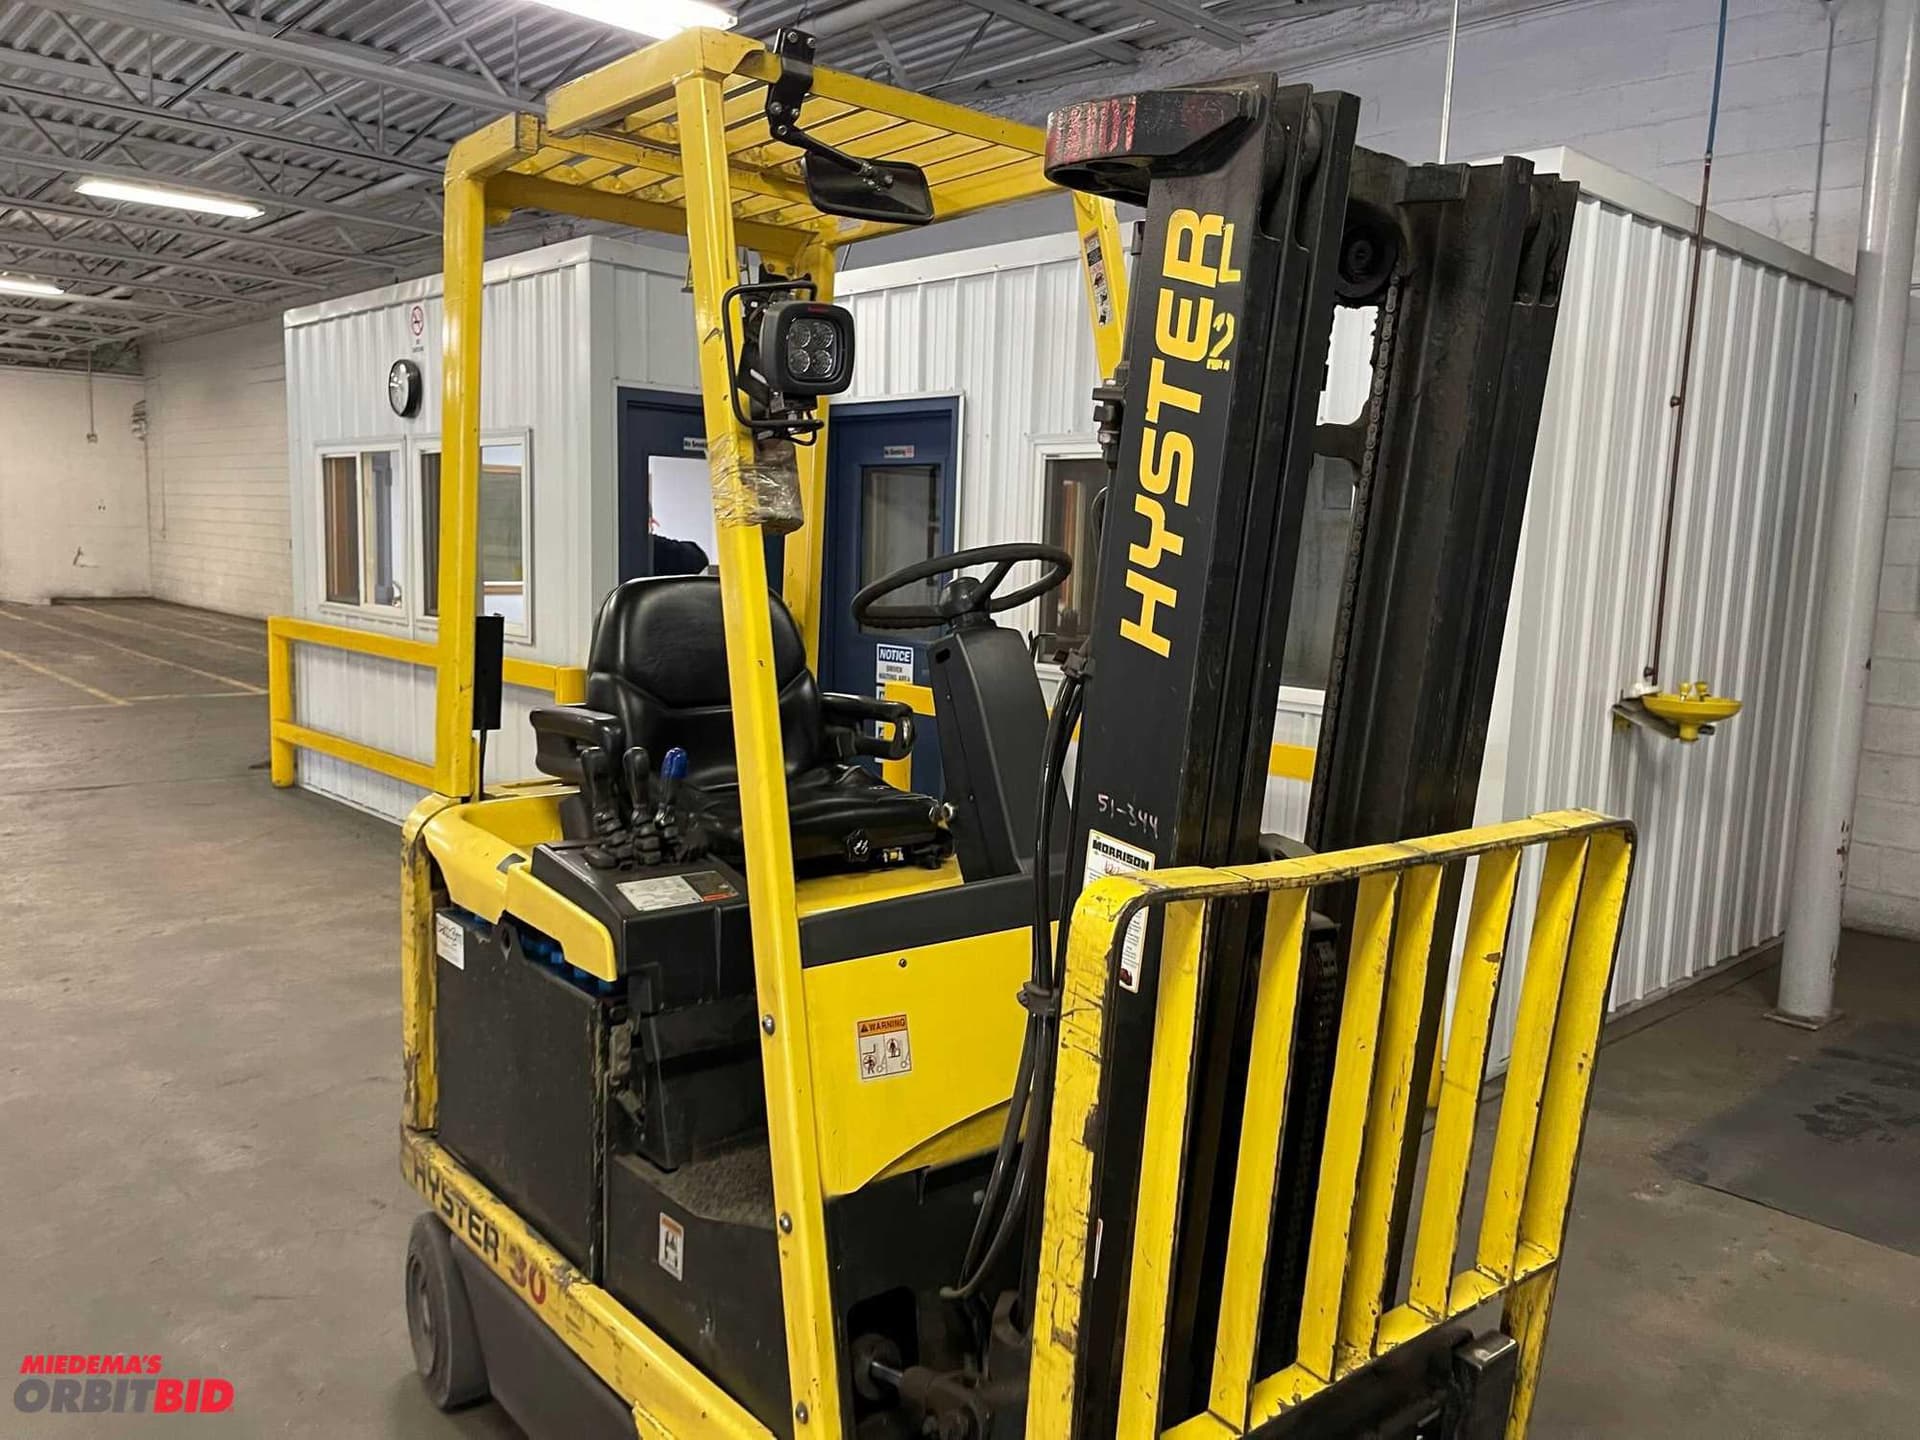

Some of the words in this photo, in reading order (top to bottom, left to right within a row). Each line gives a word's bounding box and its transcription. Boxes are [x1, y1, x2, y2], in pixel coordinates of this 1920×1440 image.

[1218, 223, 1241, 283] L
[1120, 208, 1225, 658] HYSTER
[879, 649, 910, 662] NOTICE
[1097, 793, 1159, 840] 51-344
[1092, 839, 1150, 871] MORRISON
[869, 1018, 905, 1030] WARNING
[413, 1159, 501, 1264] HYSTER
[508, 1242, 547, 1305] 30
